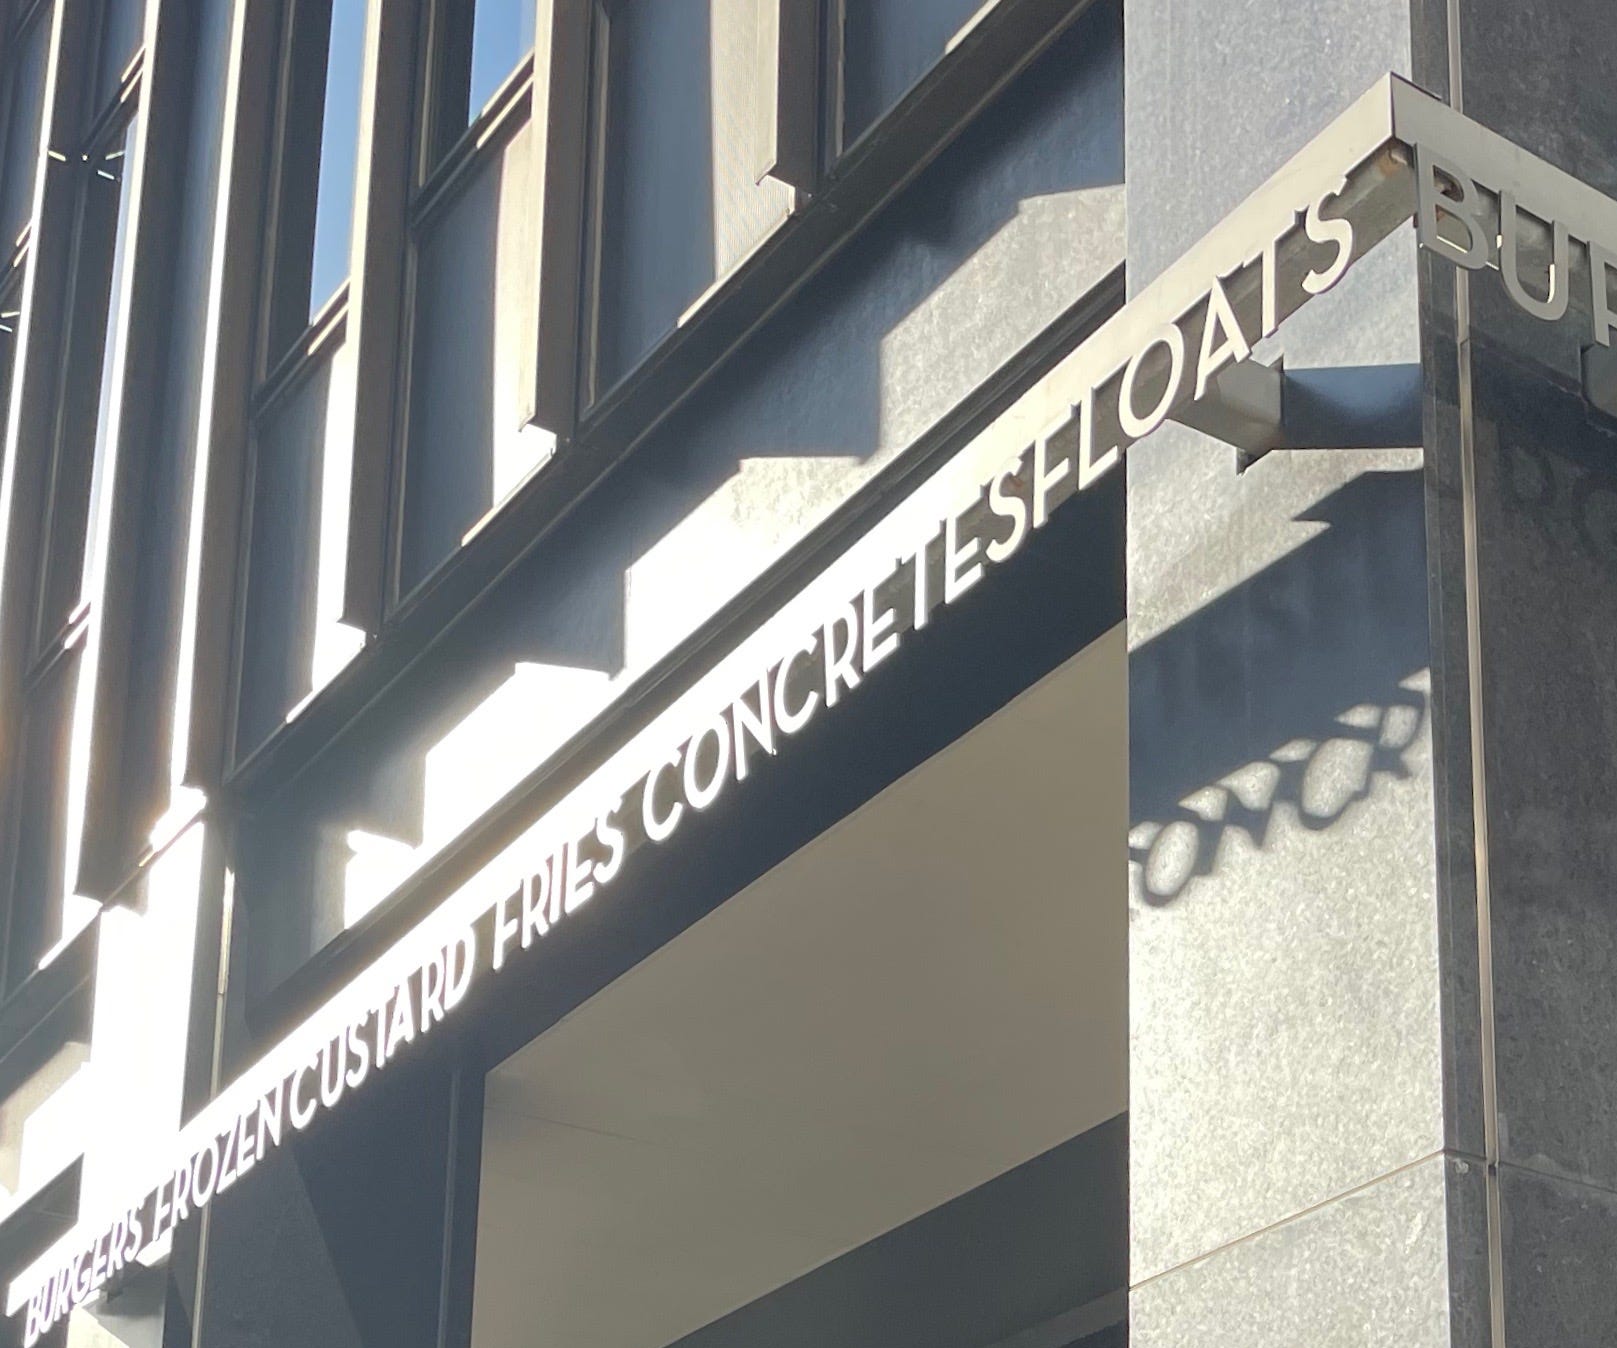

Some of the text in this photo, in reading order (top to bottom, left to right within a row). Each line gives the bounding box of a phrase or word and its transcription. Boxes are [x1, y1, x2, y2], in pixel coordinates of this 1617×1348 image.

[152, 1078, 286, 1243] FROZEN
[288, 926, 476, 1132] CUSTARD
[492, 800, 625, 971] FRIES
